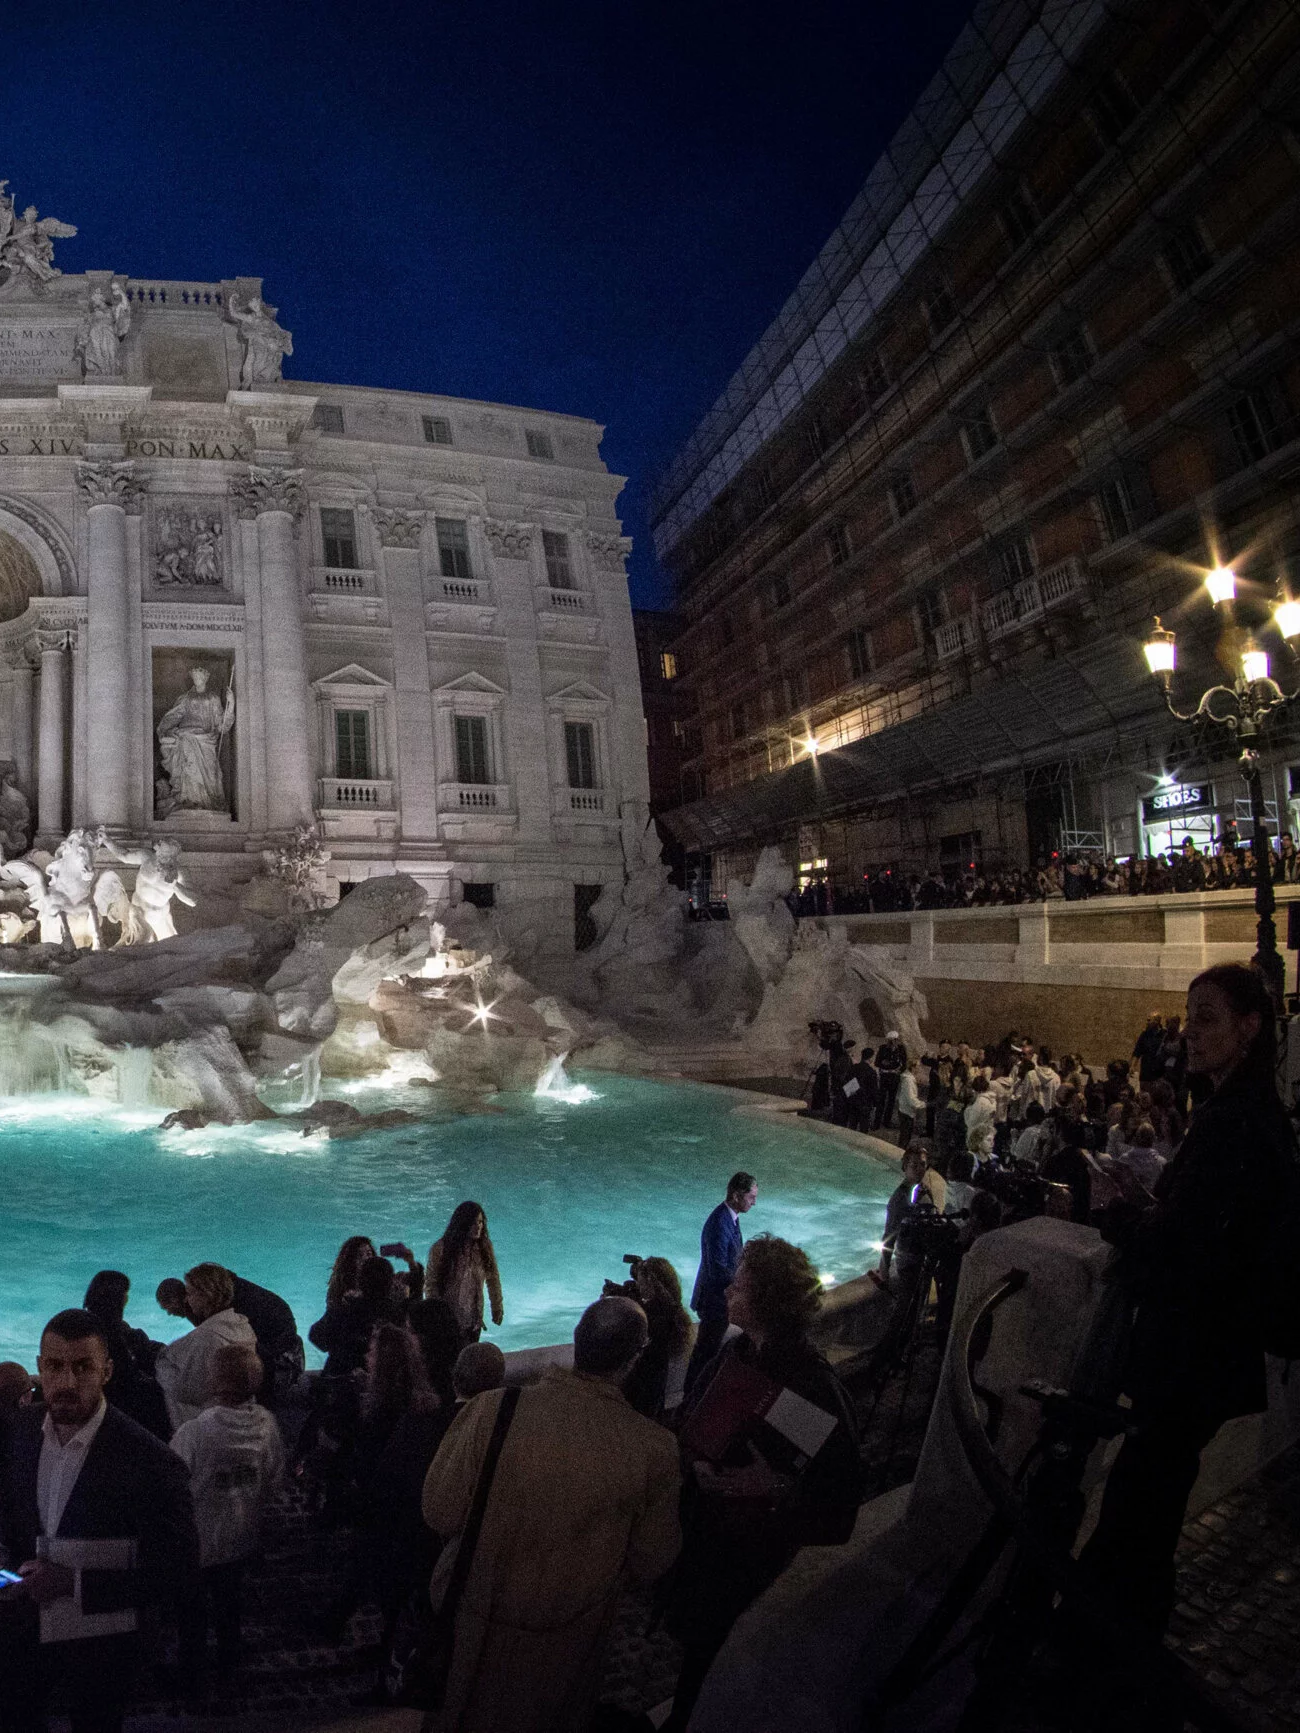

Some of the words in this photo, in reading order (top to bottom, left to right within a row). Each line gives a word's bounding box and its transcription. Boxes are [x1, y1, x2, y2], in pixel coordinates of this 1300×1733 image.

[22, 330, 56, 338] MAX
[29, 438, 75, 456] XIV
[126, 440, 175, 457] PON
[189, 442, 246, 460] MAX
[1153, 788, 1201, 809] SHOES
